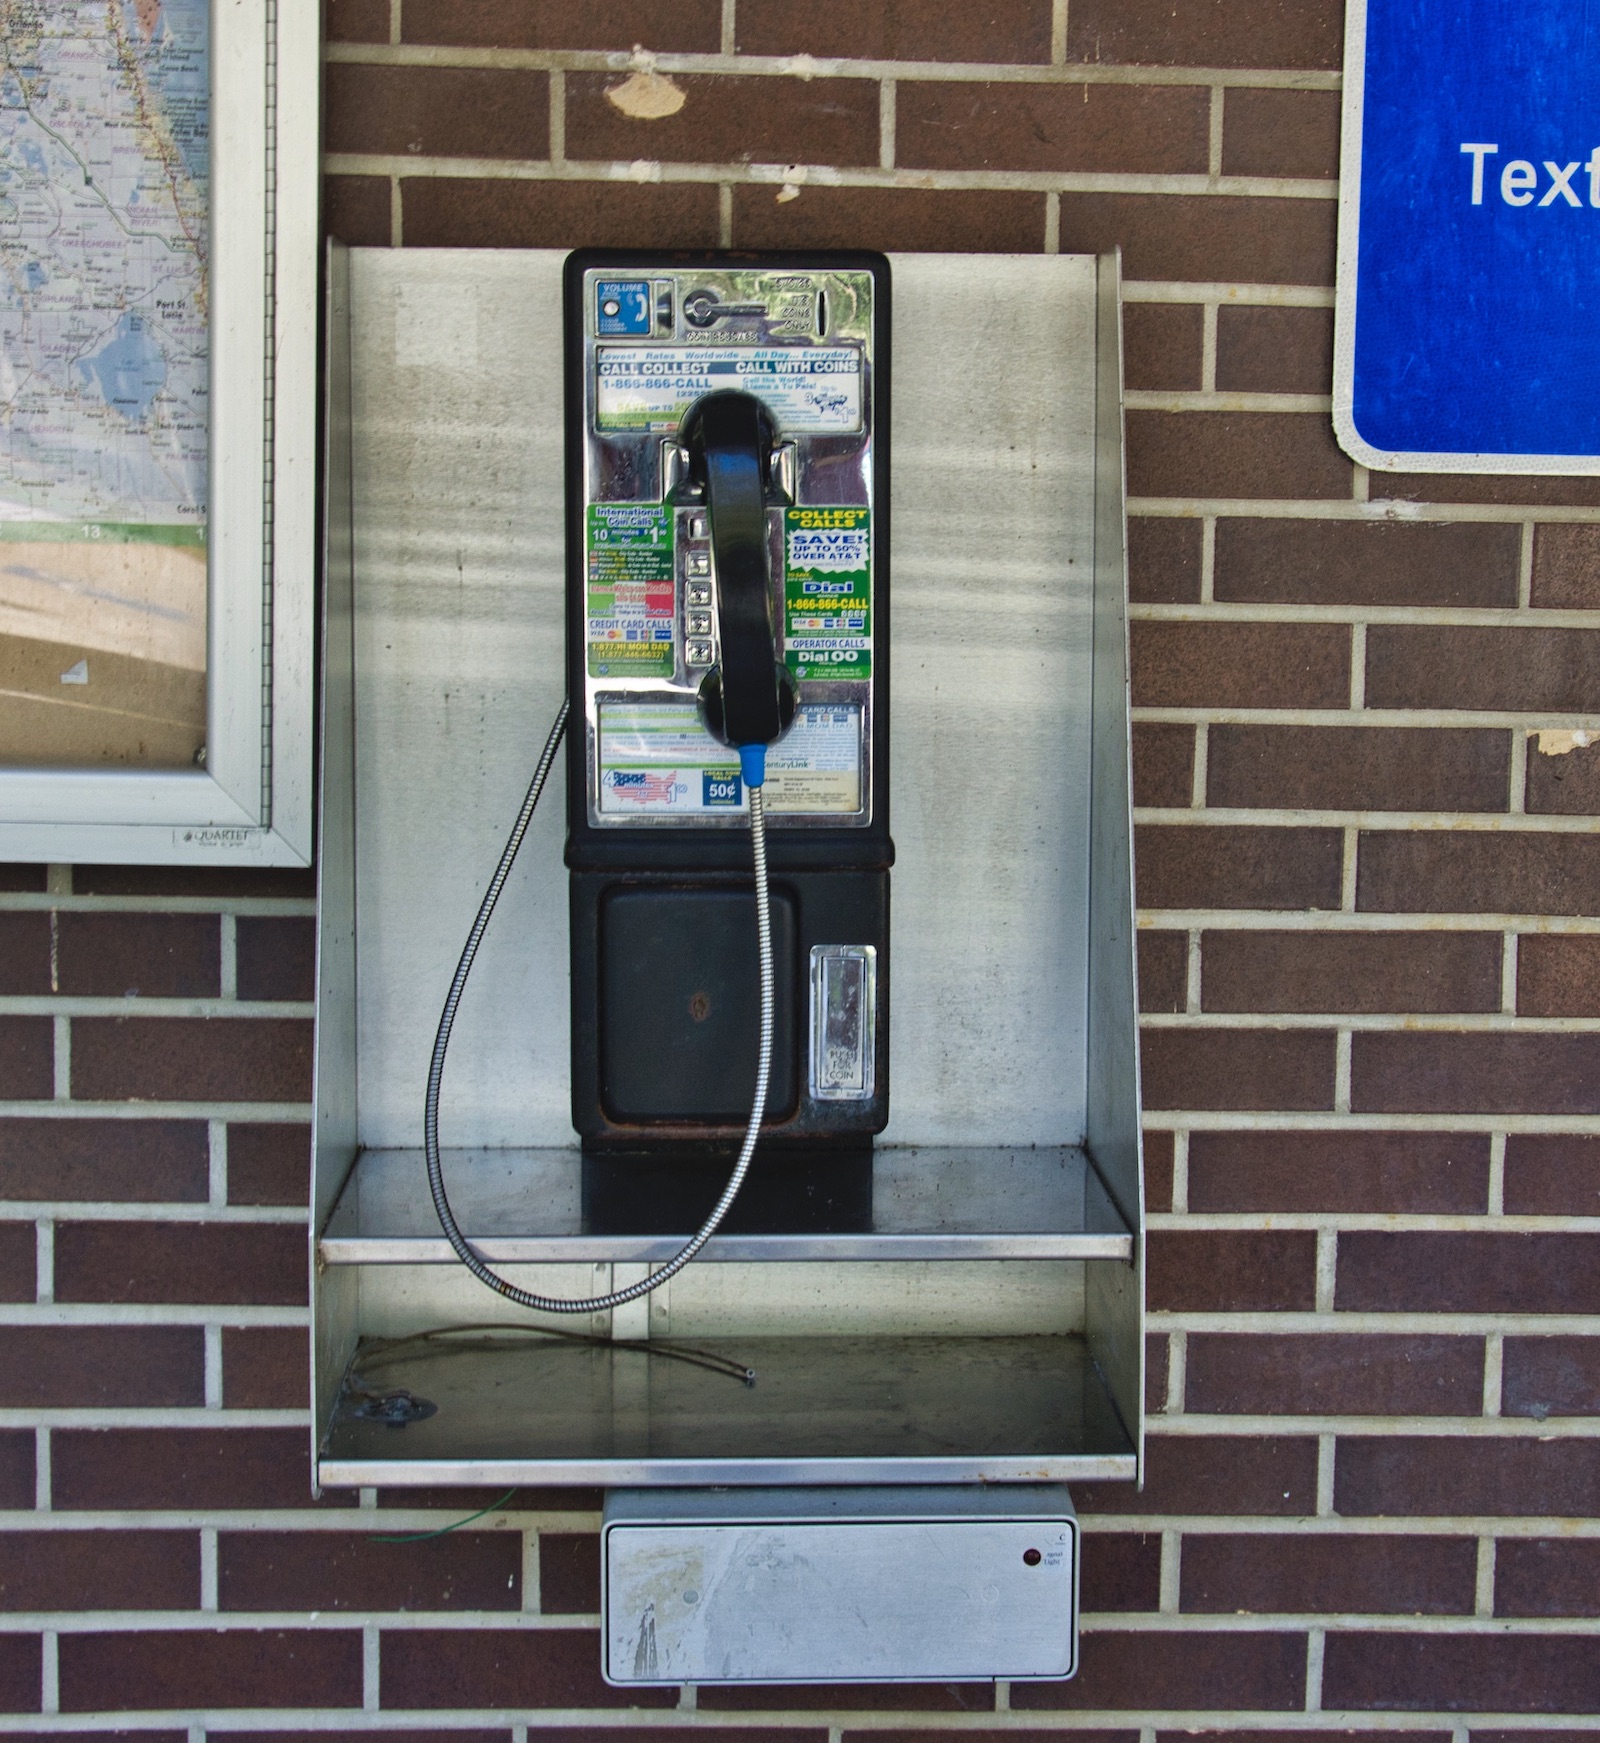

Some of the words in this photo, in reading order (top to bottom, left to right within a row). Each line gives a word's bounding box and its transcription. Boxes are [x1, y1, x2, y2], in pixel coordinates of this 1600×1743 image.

[58, 51, 96, 60] ORANGE
[1460, 143, 1600, 209] Text
[603, 283, 644, 292] VOLUME
[156, 300, 175, 309] Port
[600, 352, 636, 360] Lowest
[646, 352, 676, 360] Rates
[685, 351, 739, 360] Worldwide
[754, 350, 768, 359] All
[802, 350, 853, 360] Everyday!
[600, 363, 639, 375] CALL
[642, 362, 711, 375] COLLECT
[735, 361, 772, 373] CALL
[775, 361, 811, 373] WITH
[814, 361, 858, 372] COINS
[603, 378, 713, 389] 1-866-866-CALL
[597, 507, 664, 516] International
[788, 510, 867, 519] COLLECT
[608, 517, 628, 526] Coin
[630, 516, 653, 527] Calls
[800, 519, 856, 528] CALLS
[81, 524, 101, 538] 13
[593, 528, 608, 541] 10
[793, 535, 863, 544] SAVE!
[803, 581, 854, 594] Dial
[787, 598, 868, 610] 1-866-866-CALL
[590, 620, 619, 629] CREDIT
[621, 620, 644, 629] CARD
[646, 620, 672, 629] CALLS
[628, 643, 649, 651] MOM
[651, 643, 670, 651] DAD
[793, 639, 837, 649] OPERATOR
[839, 639, 865, 649] CALLS
[798, 651, 830, 662] Dial
[764, 760, 809, 770] enturyLink
[709, 782, 736, 799] 50¢
[194, 830, 249, 842] QUARTET
[833, 1061, 851, 1070] FOR
[829, 1070, 854, 1080] COIN
